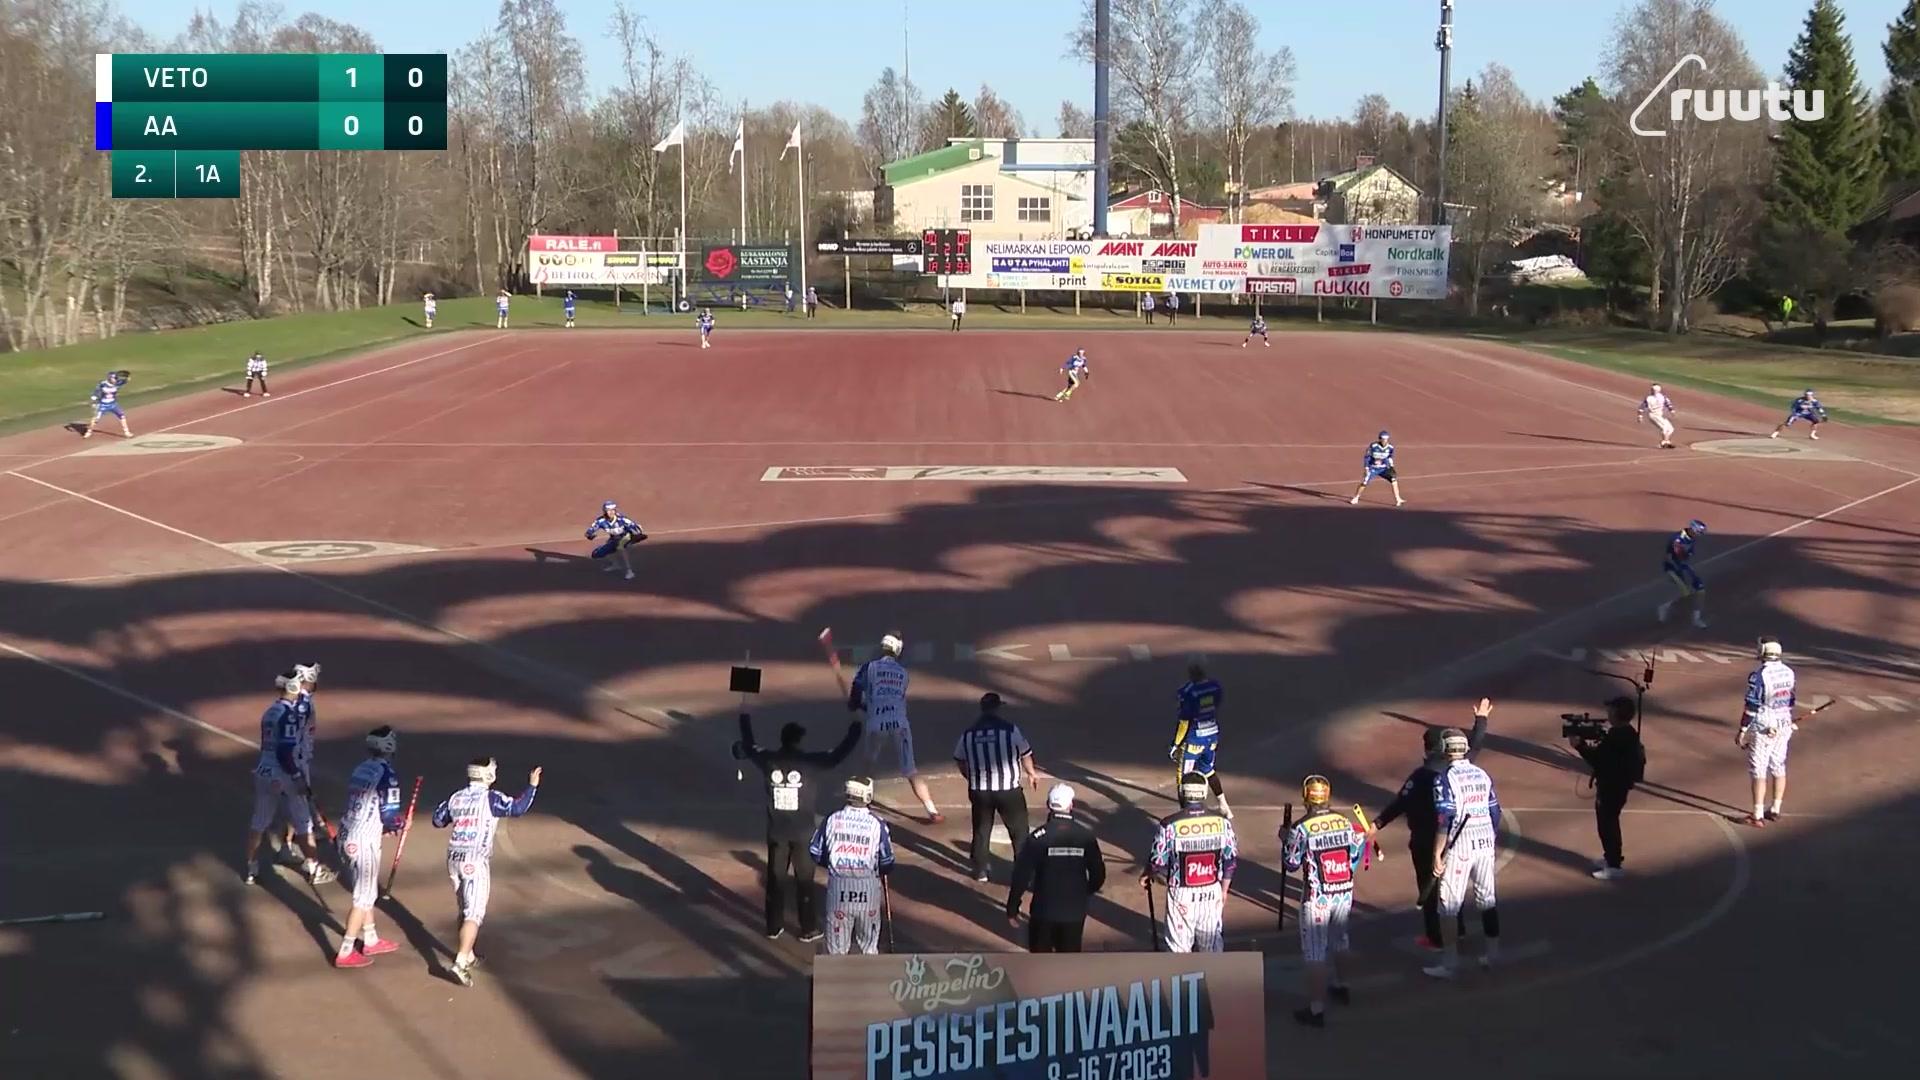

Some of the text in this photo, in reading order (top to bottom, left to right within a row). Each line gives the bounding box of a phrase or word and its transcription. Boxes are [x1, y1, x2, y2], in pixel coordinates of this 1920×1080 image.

[1422, 229, 1436, 240] OY
[545, 239, 602, 250] RALE.fi
[986, 244, 1091, 255] NELIMARKAN LEIPOMO
[1097, 242, 1144, 256] AVANT
[1151, 242, 1198, 257] AVANT
[1234, 245, 1294, 259] POWER OIL
[1388, 247, 1444, 260] Nordkalk
[741, 257, 789, 267] KASTANJA
[1116, 276, 1162, 285] SOTKA
[1167, 278, 1214, 291] AVEMET
[1219, 279, 1236, 290] OY
[1179, 818, 1222, 836] oomi
[835, 844, 869, 856] AVANT
[1187, 862, 1214, 877] Plus
[1323, 858, 1349, 874] Plus
[889, 954, 1005, 1011] Vimpelin
[866, 971, 1206, 1080] PESISFESTIVAALIT
